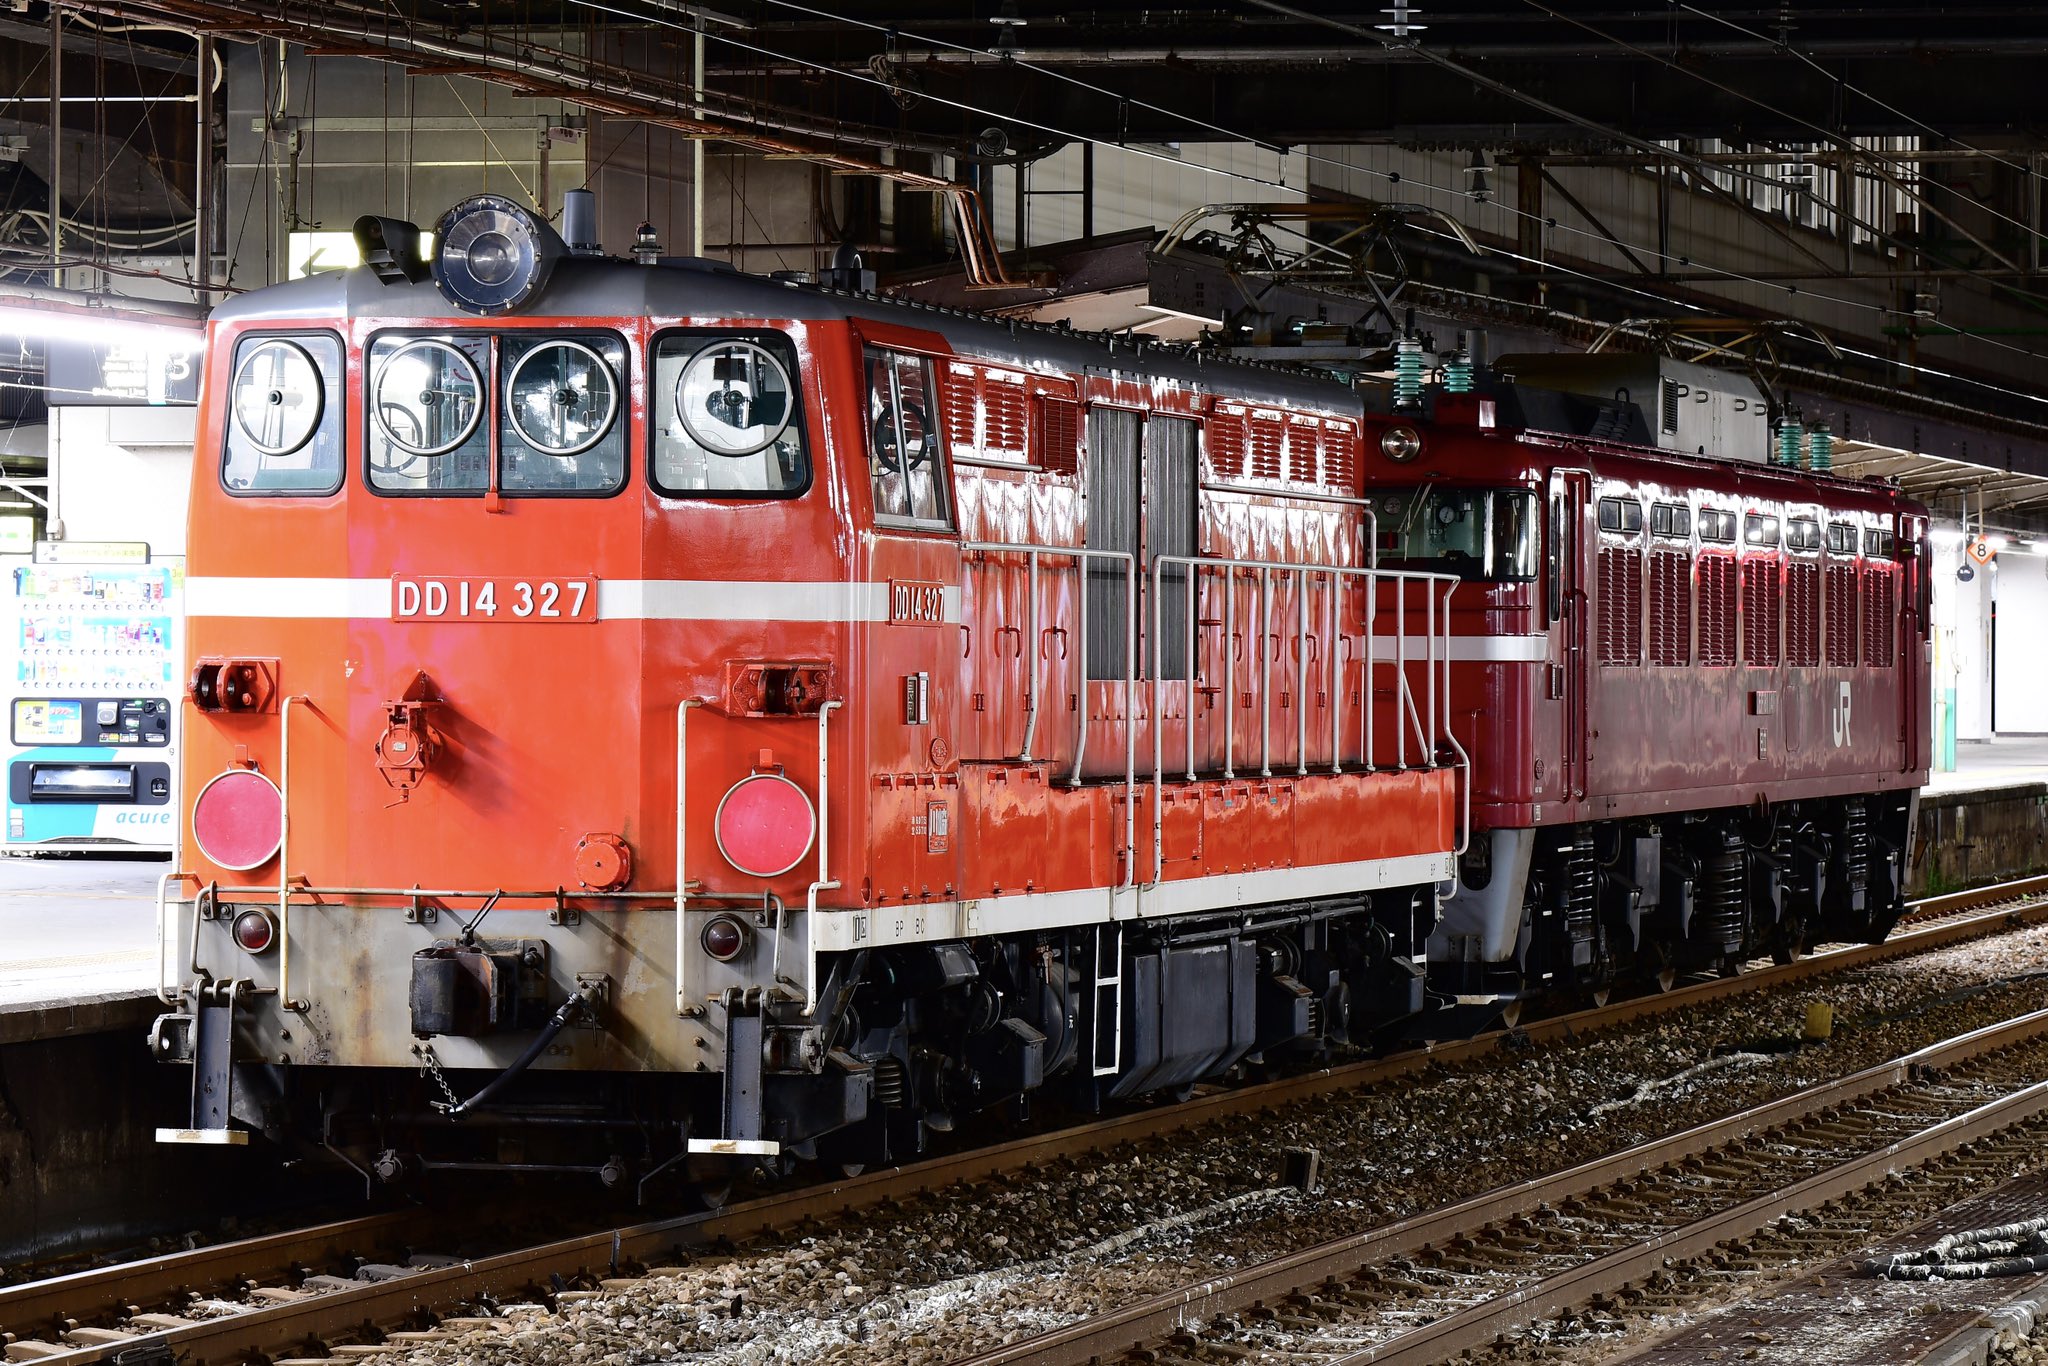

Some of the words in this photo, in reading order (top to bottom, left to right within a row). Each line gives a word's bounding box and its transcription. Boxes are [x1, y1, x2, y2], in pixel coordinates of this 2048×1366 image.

[1977, 543, 1987, 557] 8
[511, 581, 588, 617] 327
[924, 587, 944, 621] 327
[1833, 681, 1852, 748] JR
[116, 812, 170, 824] acure
[895, 920, 904, 937] BP
[915, 917, 925, 935] BC
